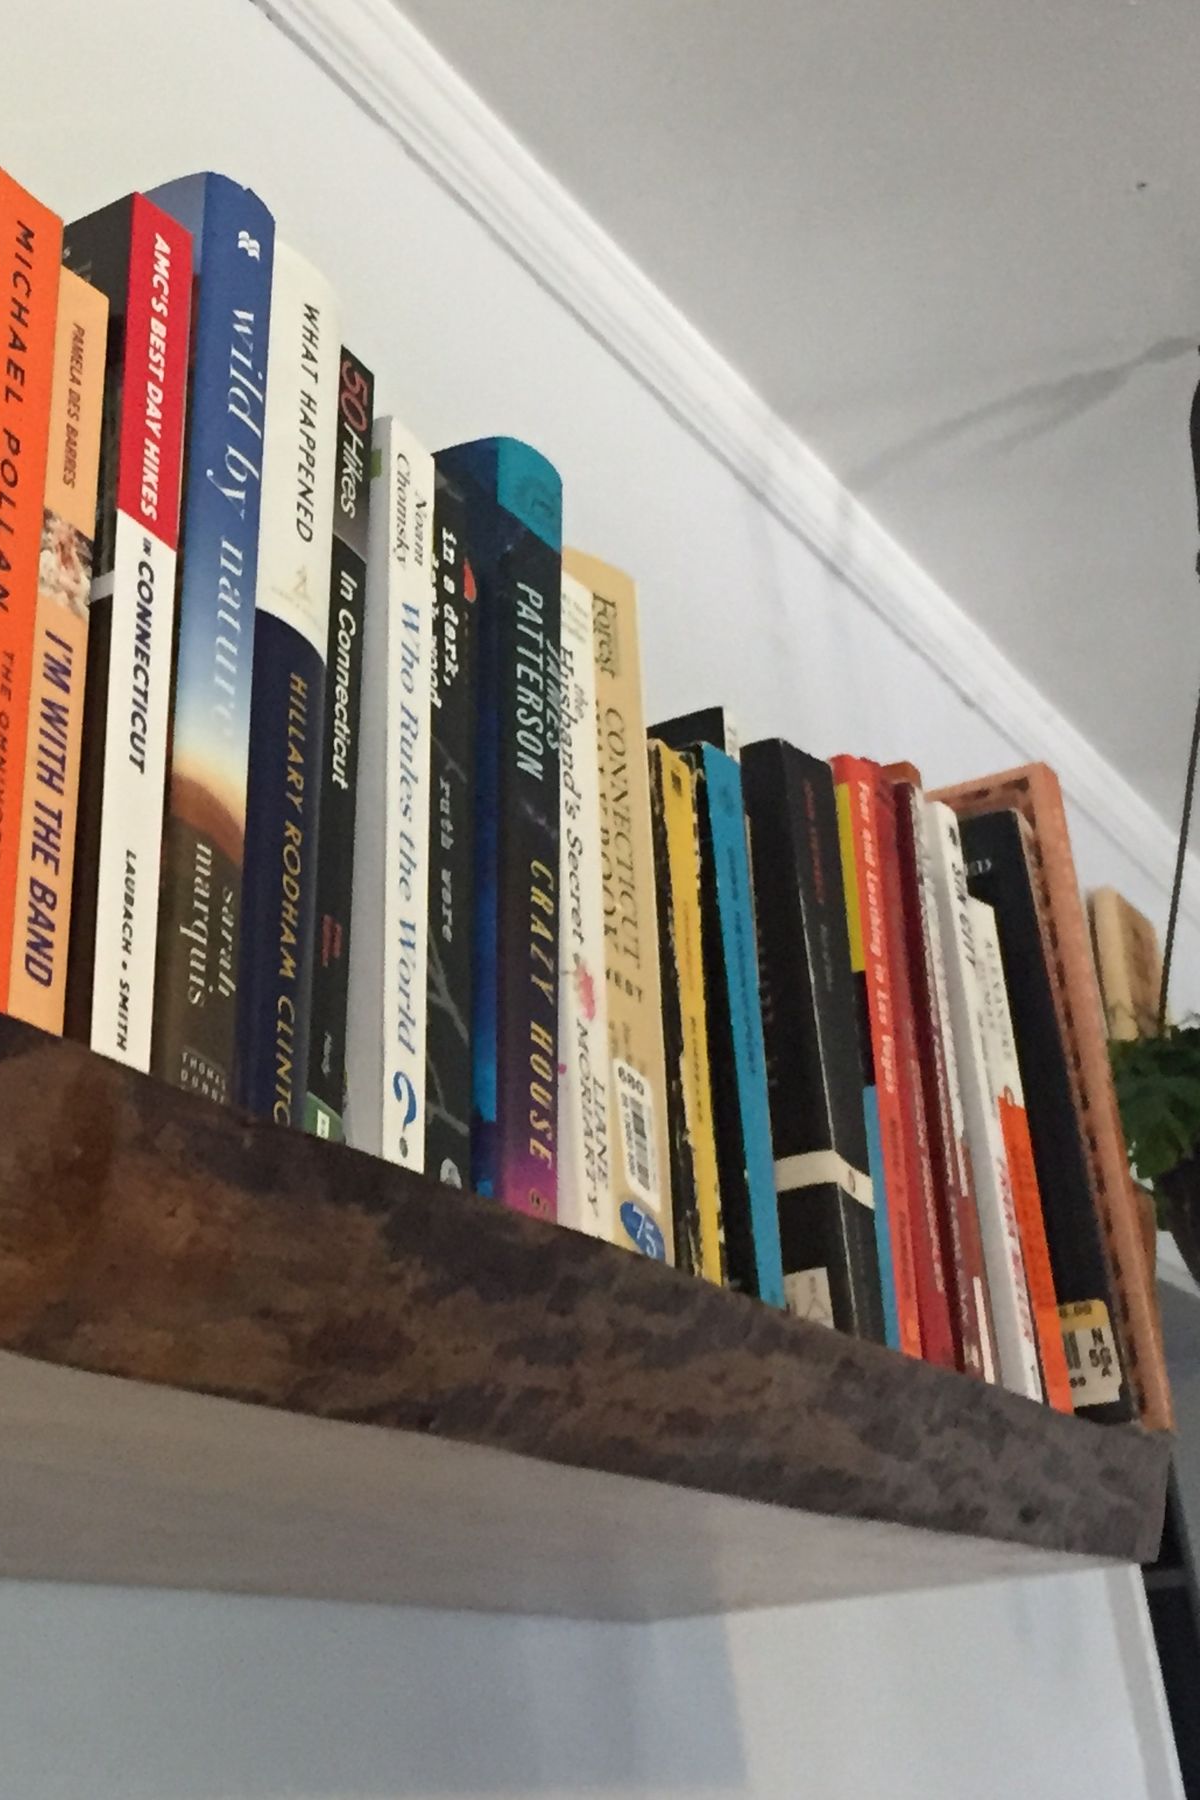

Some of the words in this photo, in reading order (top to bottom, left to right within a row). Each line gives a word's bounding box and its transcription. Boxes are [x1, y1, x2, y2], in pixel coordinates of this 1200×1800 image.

[5, 219, 36, 405] MICHAEL
[145, 232, 172, 317] AMC'S
[68, 322, 86, 385] PAMELA
[146, 317, 168, 384] BEST
[226, 309, 264, 439] wild
[300, 302, 321, 384] WHAT
[65, 386, 81, 424] DES
[144, 380, 164, 440] DAY
[340, 360, 370, 433] 50
[62, 425, 80, 489] BARRES
[139, 438, 162, 522] HIKES
[205, 445, 260, 521] by
[296, 389, 318, 544] HAPPENED
[340, 421, 366, 520] Hikes
[393, 451, 413, 571] Chomsky
[412, 488, 429, 568] Noam
[441, 526, 458, 565] in
[339, 570, 359, 602] In
[1, 651, 15, 702] THE
[43, 629, 74, 695] I'M
[128, 560, 156, 776] CONNECTICUT
[213, 535, 244, 739] nature
[400, 602, 421, 694] Who
[515, 581, 545, 783] PATTERSON
[35, 696, 70, 797] WITH
[285, 671, 308, 813] HILLARY
[332, 607, 358, 790] Connecticut
[400, 701, 420, 823] Rules
[30, 799, 63, 877] THE
[399, 830, 418, 902] the
[566, 827, 585, 945] Secret
[605, 706, 642, 970] CONNECTICUT
[24, 875, 58, 989] BAND
[121, 849, 137, 955] LAUBACH
[179, 843, 213, 1008] marquis
[216, 885, 237, 997] sarah
[279, 819, 303, 979] RODHAM
[529, 858, 555, 1006] CRAZY
[115, 976, 131, 1052] SMITH
[398, 919, 418, 1056] World
[529, 1019, 554, 1170] HOUSE
